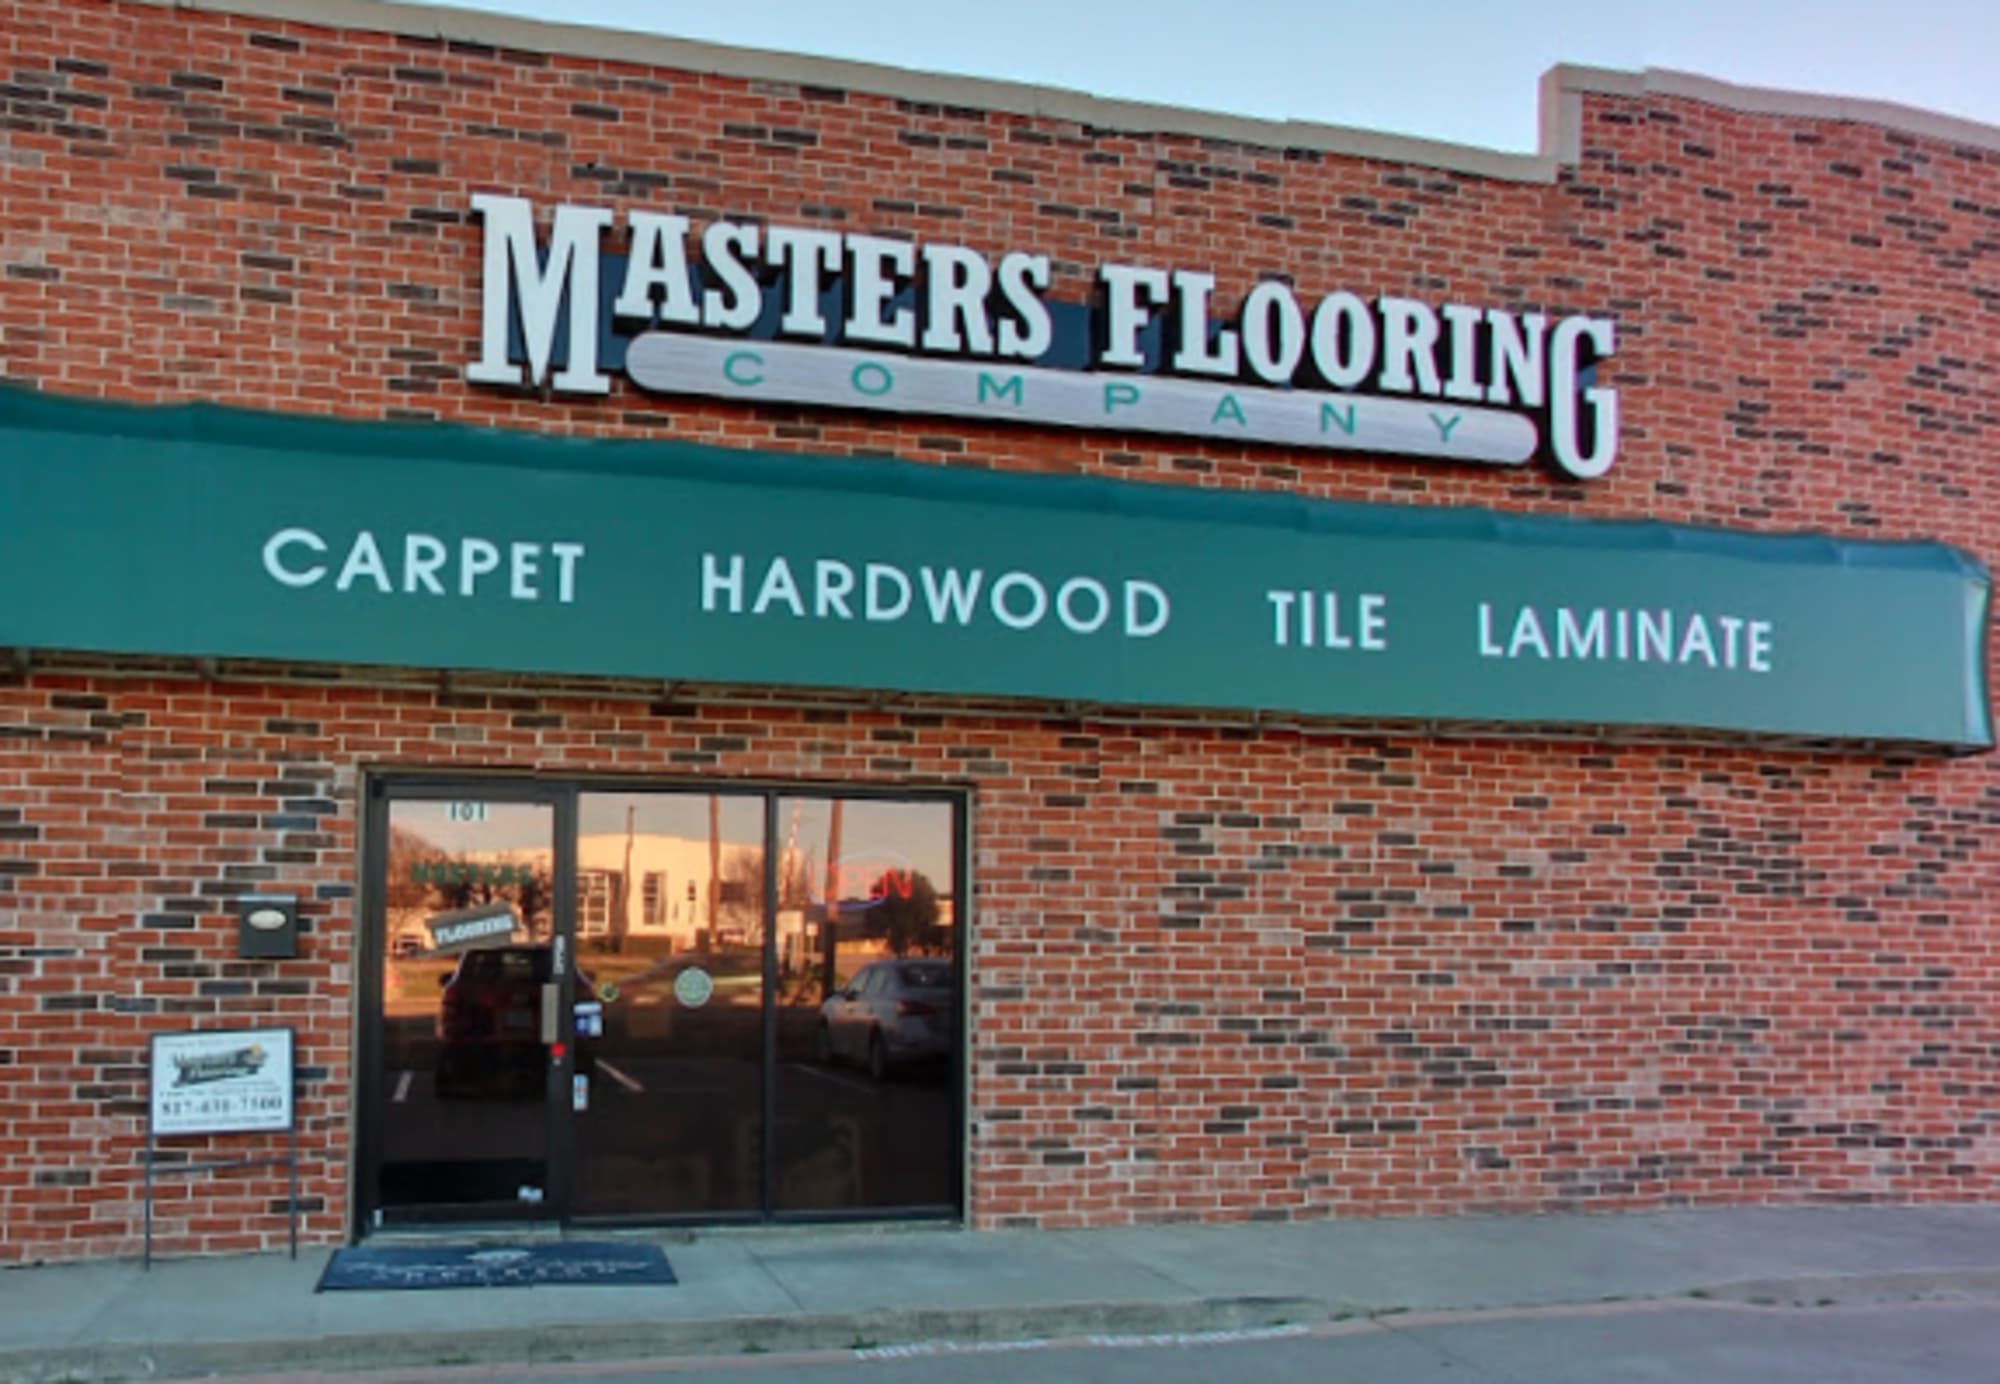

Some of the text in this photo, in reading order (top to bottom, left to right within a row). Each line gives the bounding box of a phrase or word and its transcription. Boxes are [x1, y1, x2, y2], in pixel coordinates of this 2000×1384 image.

[467, 194, 1618, 478] MASTERS FLOORING
[723, 348, 1462, 442] COMPANY
[263, 528, 1773, 674] CARPET HARDWOOD TILE LAMINATE
[449, 801, 486, 821] 101
